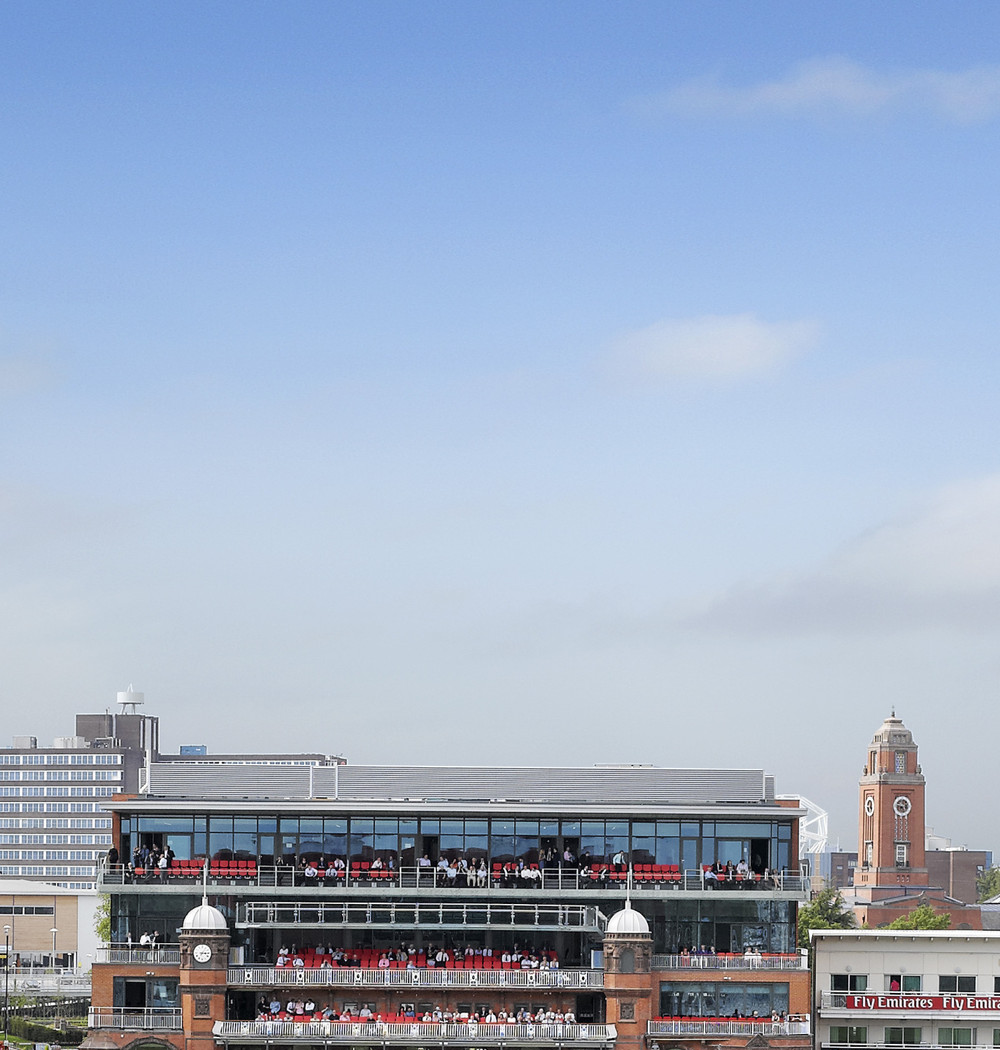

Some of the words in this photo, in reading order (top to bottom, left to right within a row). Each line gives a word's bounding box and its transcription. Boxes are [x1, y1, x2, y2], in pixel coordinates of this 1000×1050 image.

[854, 997, 875, 1010] Fly
[878, 997, 933, 1008] Emirates
[943, 997, 964, 1011] Fly
